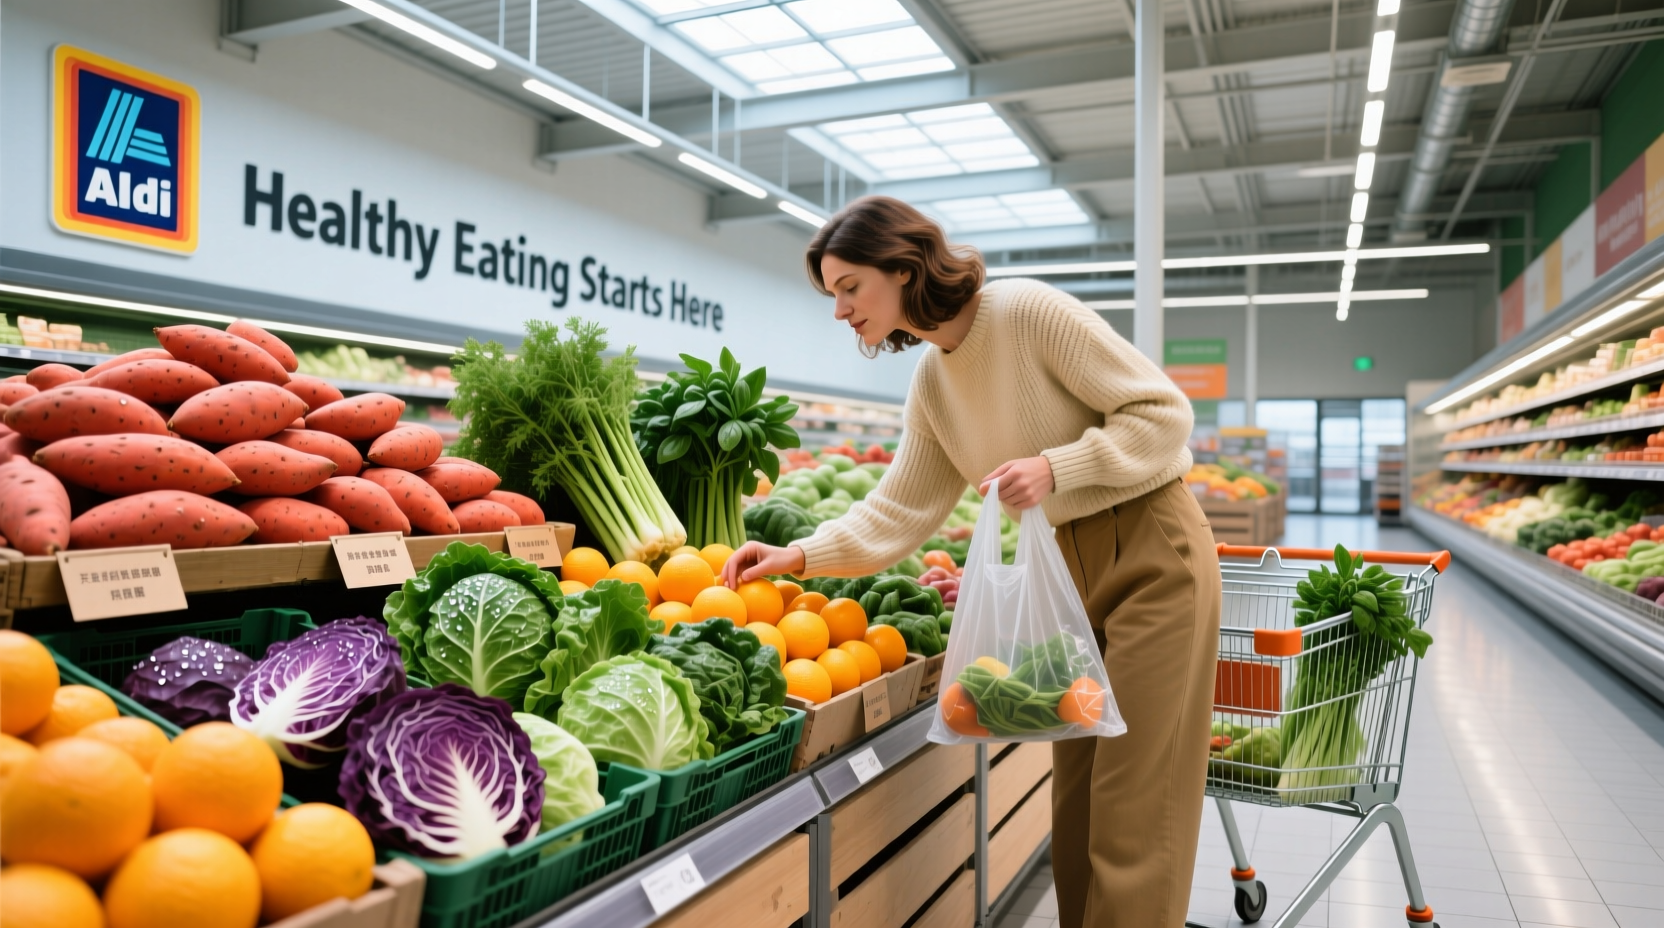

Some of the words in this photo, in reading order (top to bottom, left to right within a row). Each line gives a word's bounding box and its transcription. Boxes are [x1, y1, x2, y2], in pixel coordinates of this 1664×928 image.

[84, 167, 172, 218] Aldi
[244, 163, 440, 280] Healthy
[454, 221, 569, 308] Eating
[580, 256, 663, 317] Starts
[669, 279, 725, 332] Here
